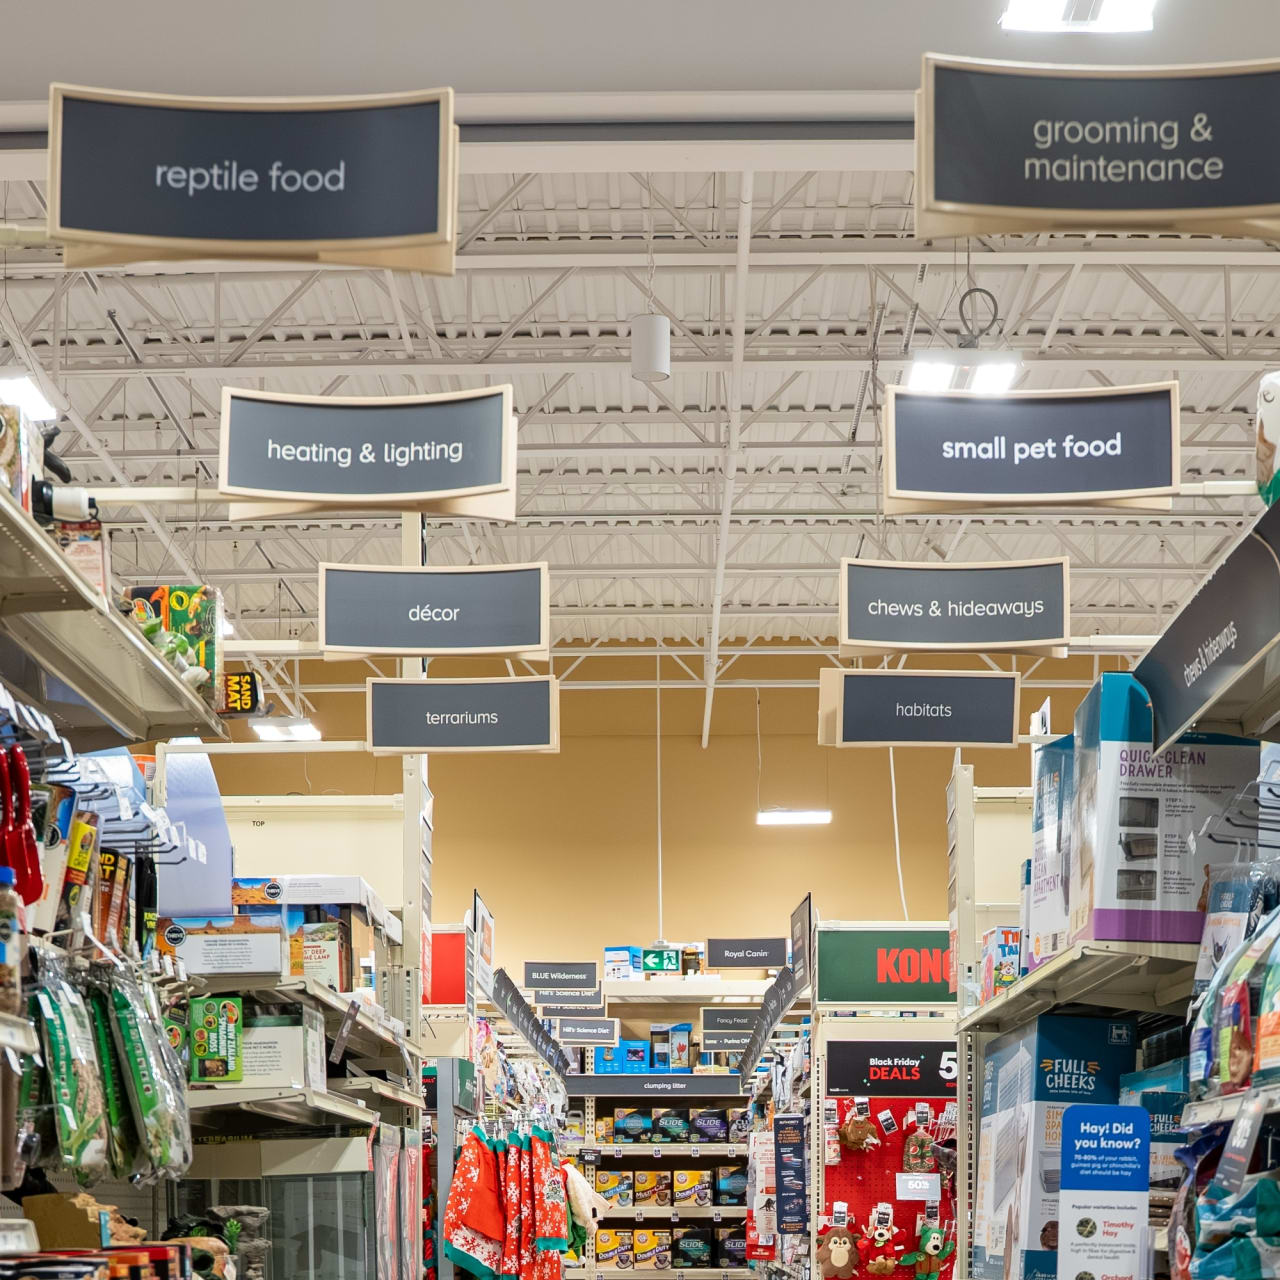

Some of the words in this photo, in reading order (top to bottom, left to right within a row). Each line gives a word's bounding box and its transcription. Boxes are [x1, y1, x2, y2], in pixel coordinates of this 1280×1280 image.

[1033, 113, 1180, 150] grooming
[1189, 113, 1214, 142] &
[1024, 154, 1224, 183] maintenance
[155, 161, 258, 196] reptile
[269, 160, 346, 193] food
[267, 439, 352, 468] heating
[358, 442, 376, 464] &
[384, 438, 463, 467] lighting
[942, 435, 1006, 460] small
[1013, 436, 1058, 467] pet
[1063, 432, 1122, 458] food
[408, 604, 460, 622] décor
[868, 598, 923, 617] chews
[928, 600, 942, 617] &
[947, 599, 1044, 618] hideaways
[227, 674, 241, 711] MAT
[240, 674, 251, 710] SAND
[896, 702, 953, 717] habitats
[426, 711, 498, 725] terrariums
[1119, 764, 1173, 778] DRAWER
[1033, 873, 1060, 897] APARTMENT
[724, 949, 745, 959] Royal
[745, 949, 768, 958] Canin
[531, 972, 550, 980] BLUE
[550, 972, 587, 980] Wilderness
[716, 1017, 732, 1025] Fancy
[209, 1032, 218, 1053] MOSS
[218, 1017, 227, 1057] SPHAGNUM
[227, 1039, 236, 1071] ZEALAND
[869, 1057, 893, 1066] Black
[894, 1057, 920, 1068] Friday
[1055, 1059, 1088, 1075] FULL
[869, 1066, 920, 1080] DEALS
[644, 1082, 671, 1090] clumping
[672, 1081, 687, 1089] litter
[1046, 1074, 1096, 1090] CHEEKS
[659, 1118, 683, 1126] SLIDE
[696, 1118, 720, 1126] SLIDE
[1045, 1110, 1062, 1120] SIM
[1154, 1113, 1175, 1123] FULL
[1080, 1122, 1109, 1136] Hay!
[1112, 1122, 1134, 1134] Did
[1074, 1139, 1097, 1150] you
[1100, 1137, 1141, 1149] know?
[1102, 1221, 1135, 1230] Timothy
[1102, 1230, 1118, 1239] Hay
[679, 1240, 704, 1249] SLIDE
